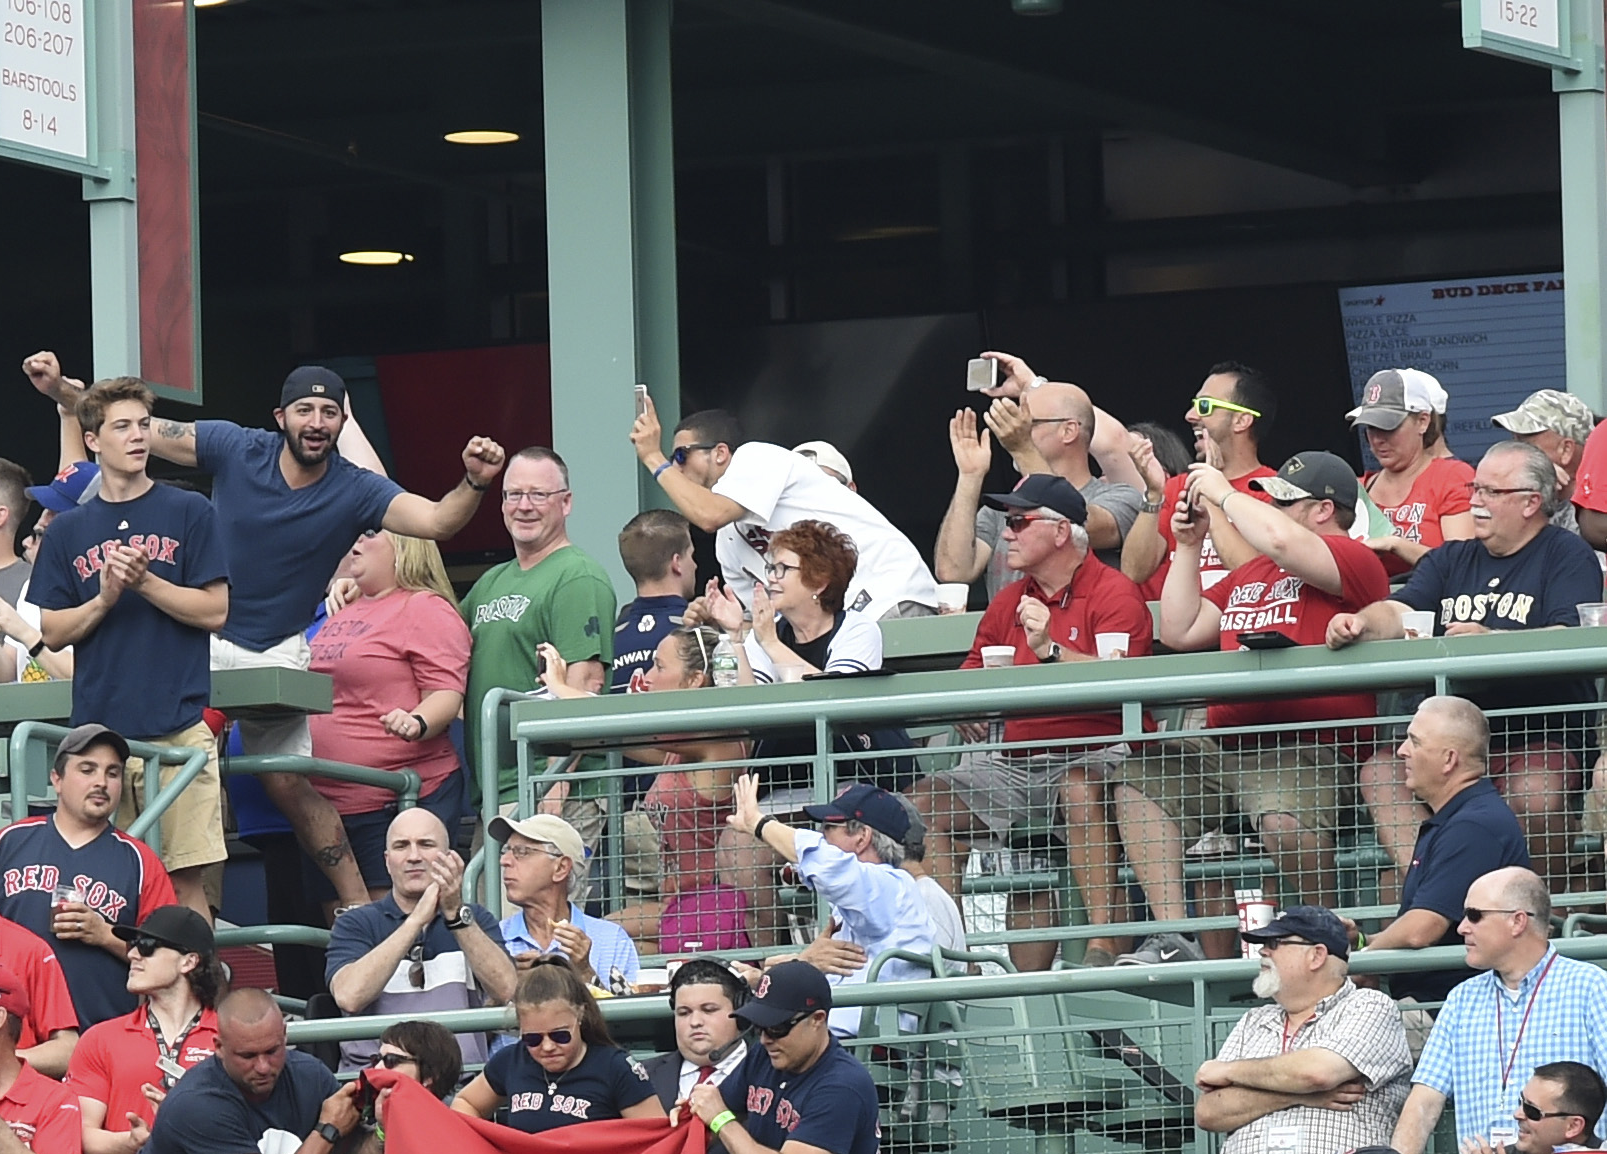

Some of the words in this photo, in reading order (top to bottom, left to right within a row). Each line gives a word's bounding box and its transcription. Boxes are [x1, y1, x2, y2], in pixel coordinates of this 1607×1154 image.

[1498, 3, 1538, 28] 15-22
[4, 22, 74, 57] 206-207
[2, 68, 77, 102] BARSTOOLS
[22, 109, 58, 136] 8-14
[1432, 286, 1473, 299] BUD
[1477, 281, 1529, 297] DECK
[1345, 314, 1383, 327] WHOLE
[1386, 313, 1417, 325] PIZZA
[1346, 328, 1377, 340] PIZZA
[1379, 327, 1409, 338] SLICE
[1348, 341, 1371, 352] HOT
[1373, 337, 1427, 350] PASTRAMI
[1429, 333, 1488, 346] SANDWICH
[1350, 353, 1396, 366] PRETZEL
[1400, 351, 1433, 362] BRAID
[128, 534, 180, 565] SOX
[1220, 603, 1298, 632] BASEBALL
[1440, 591, 1534, 626] BOSTON
[4, 864, 60, 897] RED
[73, 874, 127, 923] SOX
[755, 974, 771, 998] B
[511, 1092, 544, 1113] RED
[550, 1094, 592, 1120] SOX
